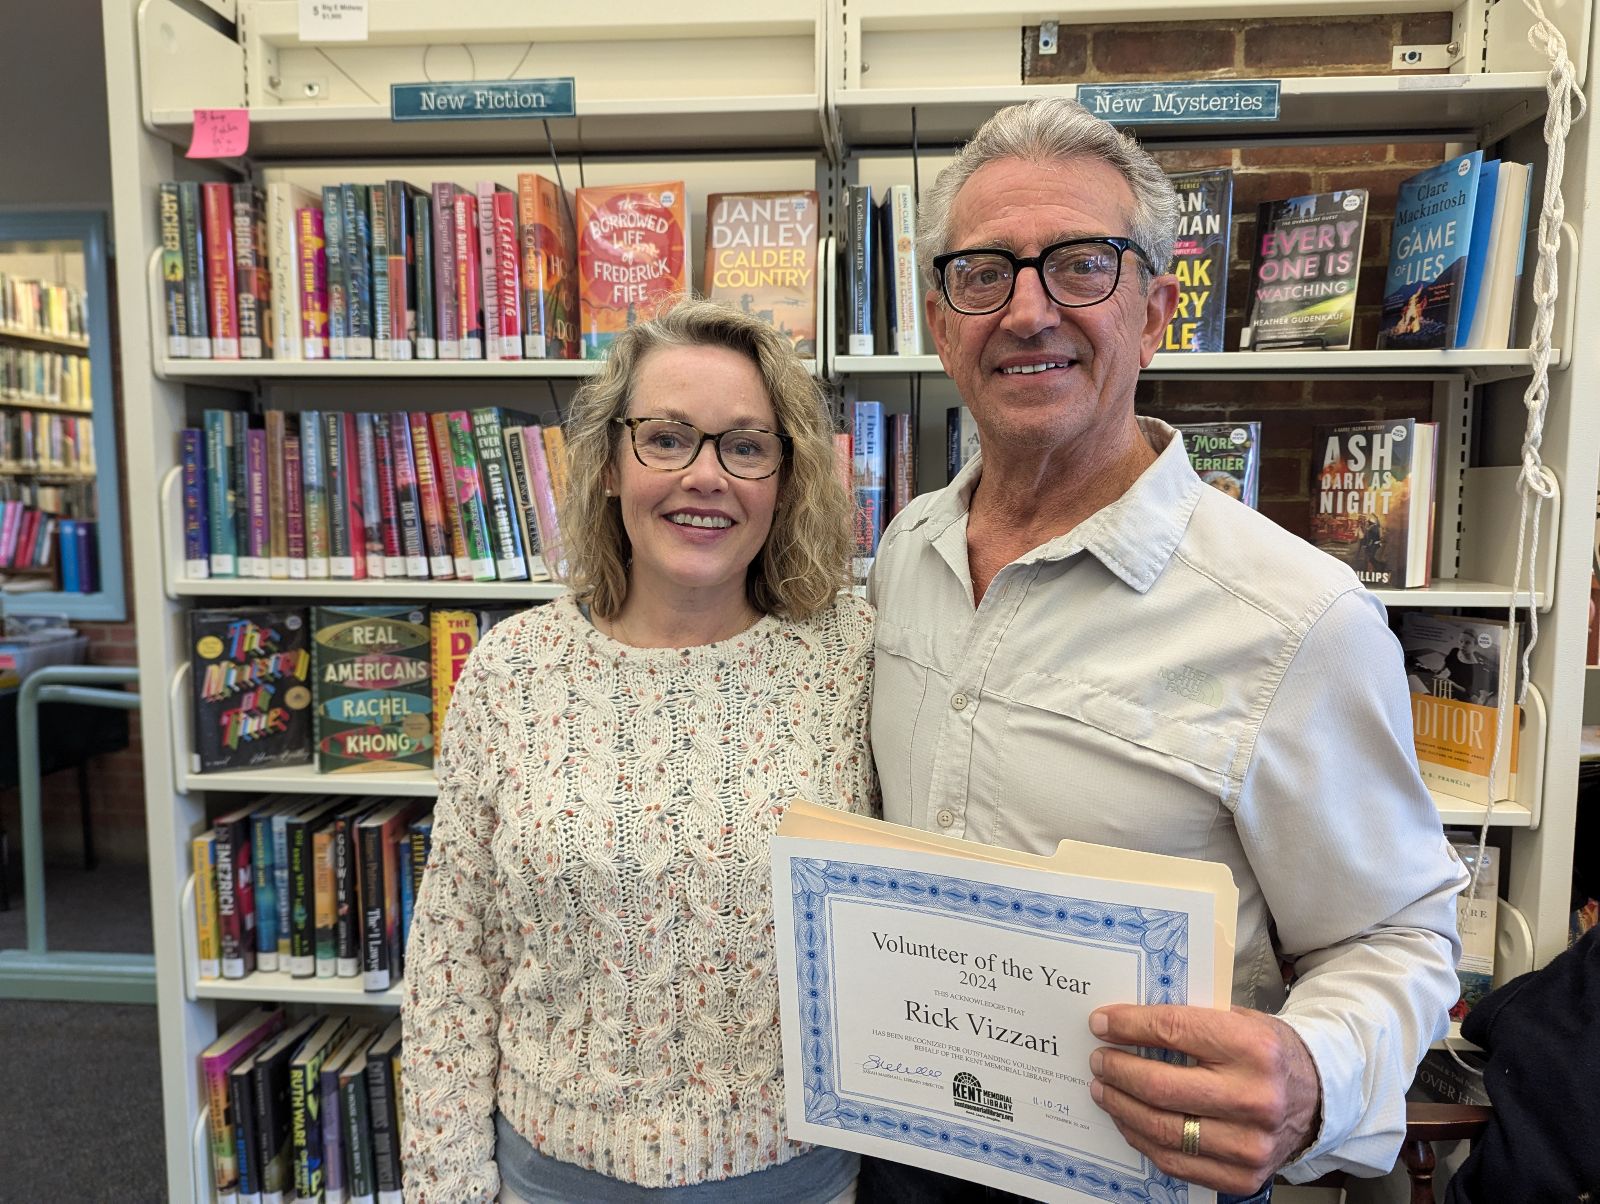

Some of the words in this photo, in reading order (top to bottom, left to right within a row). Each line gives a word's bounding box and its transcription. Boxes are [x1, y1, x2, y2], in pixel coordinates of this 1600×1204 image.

[420, 92, 466, 111] New
[475, 90, 547, 109] Fiction
[1094, 95, 1145, 113] New
[1152, 93, 1263, 115] Mysteries
[441, 189, 450, 206] The
[524, 178, 533, 193] THE
[1417, 181, 1448, 202] Clare
[328, 193, 336, 214] BAD
[456, 201, 466, 230] RODDY
[480, 195, 493, 238] TEDDY
[524, 198, 534, 234] HOUSE
[718, 198, 808, 223] JANET
[1397, 190, 1466, 227] Mackintosh
[161, 192, 179, 251] ARCHER
[440, 210, 450, 252] Magnolia
[590, 212, 668, 240] BORROWED
[235, 216, 252, 267] BURKE
[328, 217, 340, 264] TOURISTS
[458, 234, 467, 260] DOYLE
[525, 236, 535, 248] OF
[613, 230, 645, 249] LIFE
[713, 224, 814, 248] DAILEY
[857, 243, 863, 252] of
[1261, 220, 1358, 257] EVERY
[1397, 220, 1457, 260] GAME
[375, 255, 387, 273] THE
[442, 255, 451, 286] Palace
[498, 216, 516, 317] SCAFFOLDING
[594, 257, 670, 283] FREDERICK
[720, 249, 806, 268] CALDER
[1259, 255, 1318, 282] ONE
[1326, 252, 1351, 275] IS
[1406, 253, 1446, 286] LIES
[484, 267, 497, 299] EMILY
[714, 268, 811, 288] COUNTRY
[1256, 281, 1348, 301] WATCHING
[214, 274, 229, 336] THRONE
[332, 284, 342, 313] CARO
[614, 283, 648, 303] FIFE
[239, 293, 257, 335] CLETE
[375, 277, 391, 339] UNWEDDING
[1253, 317, 1288, 326] HEATHER
[1291, 312, 1344, 324] GUDENKAUF
[473, 412, 498, 426] SAME
[475, 427, 489, 437] AS
[490, 425, 499, 435] IT
[305, 420, 315, 445] ANN
[478, 437, 500, 450] EVER
[854, 413, 865, 456] Crowd
[1192, 435, 1235, 453] MORE
[307, 448, 317, 482] HOOD
[413, 426, 432, 485] SHANGHAI
[481, 449, 502, 459] WAS
[1188, 453, 1245, 471] TERRIER
[1323, 433, 1393, 472] ASH
[397, 448, 410, 484] JANCE
[379, 463, 395, 518] JOHANSEN
[1321, 472, 1365, 490] DARK
[1371, 471, 1393, 490] AS
[402, 501, 416, 520] DEN
[487, 464, 503, 500] CLAIRE
[495, 505, 515, 559] LOMBARDO
[1320, 491, 1393, 514] NIGHT
[353, 626, 398, 644] REAL
[448, 619, 470, 628] THE
[227, 619, 281, 662] The
[324, 661, 428, 682] AMERICANS
[1433, 678, 1454, 699] THE
[343, 698, 412, 717] RACHEL
[220, 707, 289, 750] Time
[1416, 701, 1483, 750] DITOR
[346, 733, 410, 753] KHONG
[1438, 775, 1471, 788] FRANKLIN
[412, 834, 425, 862] SARAH
[292, 848, 300, 872] KNOW
[296, 874, 304, 896] WHAT
[336, 834, 347, 901] GODWIN
[215, 850, 235, 915] MEZRICH
[366, 909, 380, 928] The
[872, 931, 968, 965] Volunteer
[975, 953, 997, 972] of
[1002, 957, 1033, 981] the
[1040, 965, 1091, 996] Year
[960, 971, 998, 992] 2024
[934, 990, 949, 998] THIS
[949, 993, 1006, 1011] ACKNOWLEDGES
[1007, 1006, 1026, 1016] THAT
[904, 999, 960, 1031] Rick
[966, 1012, 1060, 1057] Vizzari
[872, 1029, 886, 1037] HAS
[886, 1030, 904, 1040] BEEN
[904, 1034, 947, 1049] RECOGNIZED
[948, 1044, 961, 1052] FOR
[961, 1048, 1012, 1066] OUTSTANDING
[1012, 1060, 1054, 1077] VOLUNTEER
[1055, 1072, 1086, 1086] EFFORTS
[914, 1045, 939, 1055] BEHALF
[950, 1052, 963, 1060] THE
[964, 1055, 984, 1066] KENT
[984, 1061, 1022, 1076] MEMORIAL
[1023, 1071, 1052, 1084] LIBRARY
[368, 1061, 385, 1085] CITY
[903, 1077, 922, 1085] LIBRARY
[922, 1081, 945, 1090] DIRECTOR
[1420, 1070, 1456, 1100] OVER
[290, 1069, 303, 1107] RUTH
[953, 1082, 983, 1103] KENT
[983, 1089, 1013, 1105] MEMORIAL
[953, 1100, 1014, 1123] kentmemoriallibrary.org
[983, 1097, 1013, 1112] LIBRARY
[294, 1109, 306, 1147] WARE
[1046, 1113, 1072, 1124] NOVEMBER
